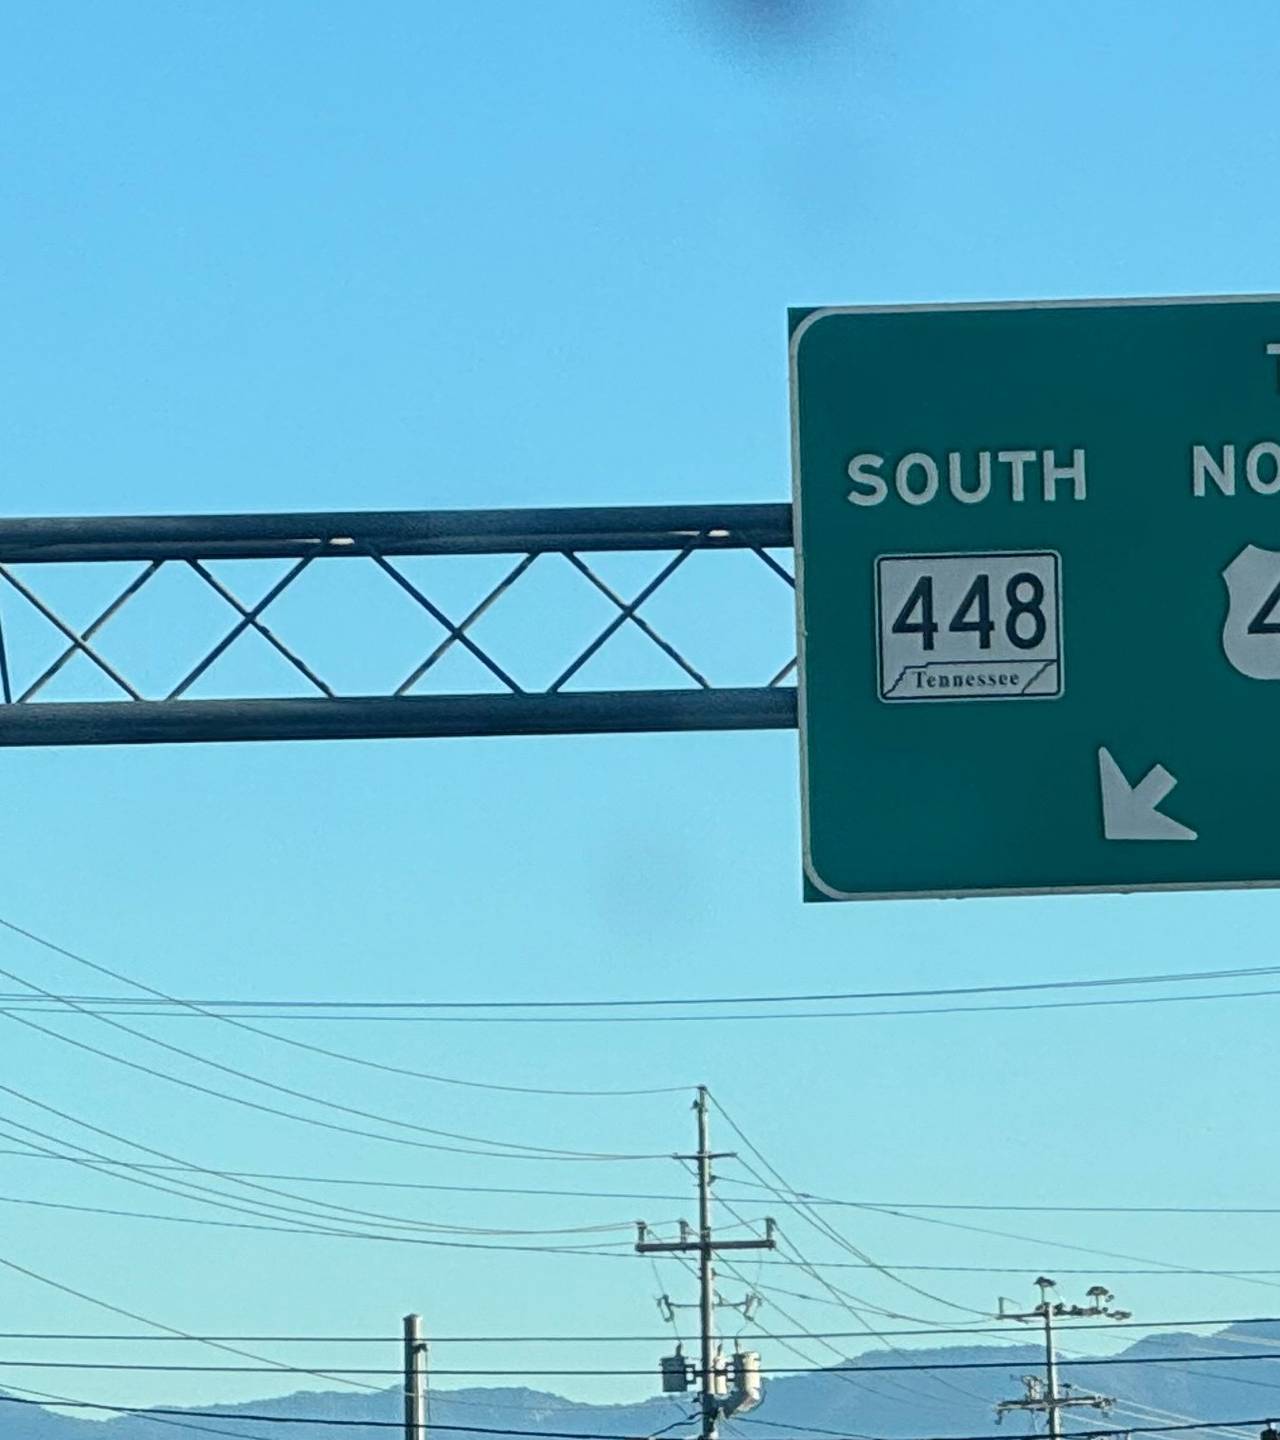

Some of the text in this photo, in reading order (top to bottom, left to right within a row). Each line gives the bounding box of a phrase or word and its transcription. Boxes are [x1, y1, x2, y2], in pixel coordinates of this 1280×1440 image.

[846, 448, 1088, 507] SOUTH
[890, 571, 1048, 653] 448
[914, 670, 1022, 692] Tennessee
